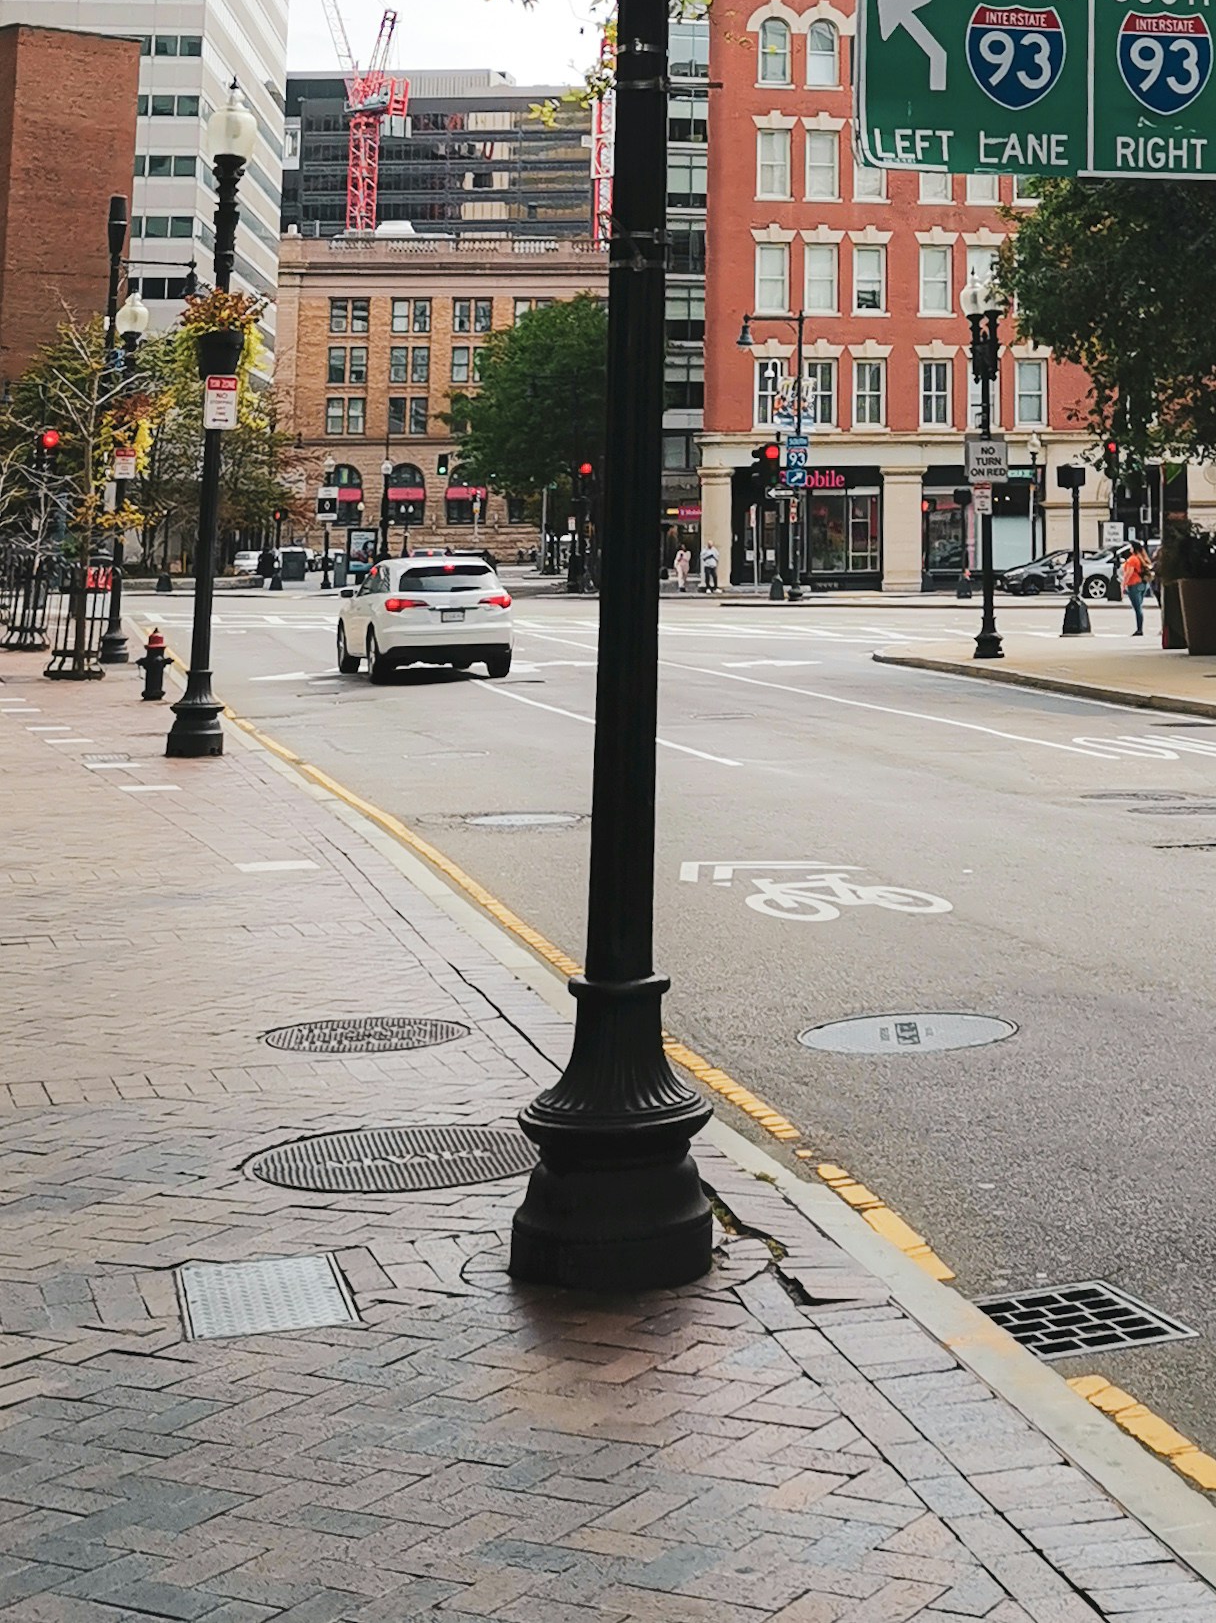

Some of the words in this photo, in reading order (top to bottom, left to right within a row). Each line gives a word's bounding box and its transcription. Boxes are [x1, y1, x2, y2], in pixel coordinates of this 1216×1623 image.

[985, 12, 1048, 27] INTERSTATE
[1135, 19, 1195, 33] INTERSTATE
[979, 30, 1052, 89] 93
[1130, 37, 1200, 94] 93
[874, 128, 954, 162] LEFT
[979, 130, 1069, 165] LANE
[1116, 136, 1208, 169] RIGHT
[981, 446, 996, 455] NO
[788, 452, 806, 466] 93
[975, 457, 1002, 466] TURN
[970, 468, 985, 476] ON
[987, 468, 1006, 476] RED
